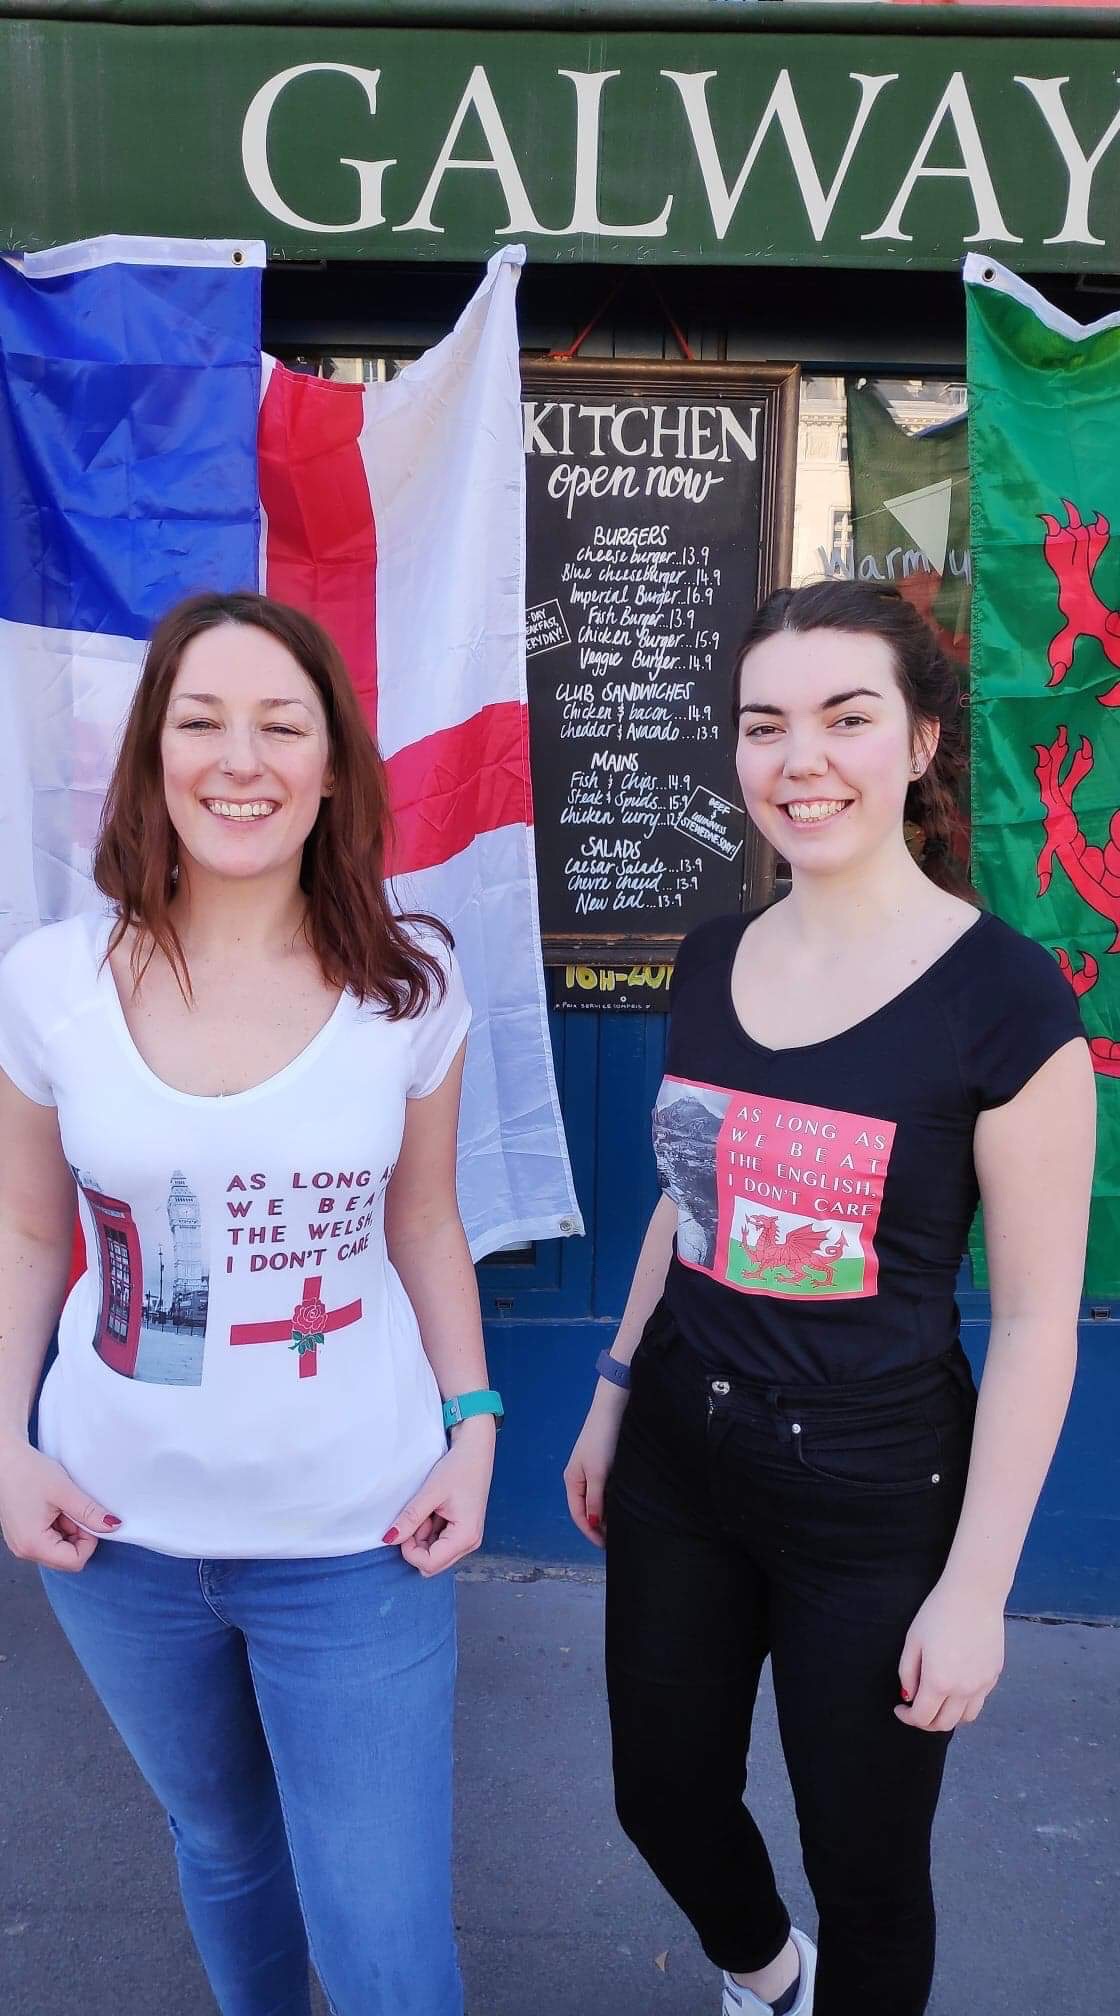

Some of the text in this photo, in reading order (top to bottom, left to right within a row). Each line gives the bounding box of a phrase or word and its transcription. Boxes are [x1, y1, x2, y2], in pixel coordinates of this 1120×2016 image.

[241, 61, 1120, 245] GALWAY
[521, 401, 762, 462] KITCHEN
[547, 464, 725, 519] open now
[593, 525, 669, 547] BURGERS
[561, 563, 592, 582] Blue
[818, 546, 930, 580] Warm
[570, 583, 629, 610] Imperial
[588, 605, 618, 625] Fish
[578, 625, 632, 646] Chicken
[580, 648, 623, 677] Veggie
[555, 682, 695, 702] CLUB SANDWICHES
[563, 701, 612, 720] Chicken
[591, 750, 639, 772] MAINS
[570, 771, 599, 789] Fish
[567, 788, 603, 805] Steak
[560, 806, 615, 824] Chicken
[581, 836, 641, 859] SALADS
[564, 857, 616, 875] Caesar
[575, 892, 608, 915] New
[737, 1106, 886, 1150] AS LONG AS
[728, 1151, 762, 1172] THE
[731, 1127, 881, 1174] WE BEAT
[226, 1173, 266, 1192] AS
[292, 1170, 371, 1189] LONG
[728, 1173, 874, 1216] I DON'T CARE
[226, 1199, 284, 1218] WE
[227, 1225, 286, 1245] THE
[226, 1232, 370, 1273] I DON'T CARE
